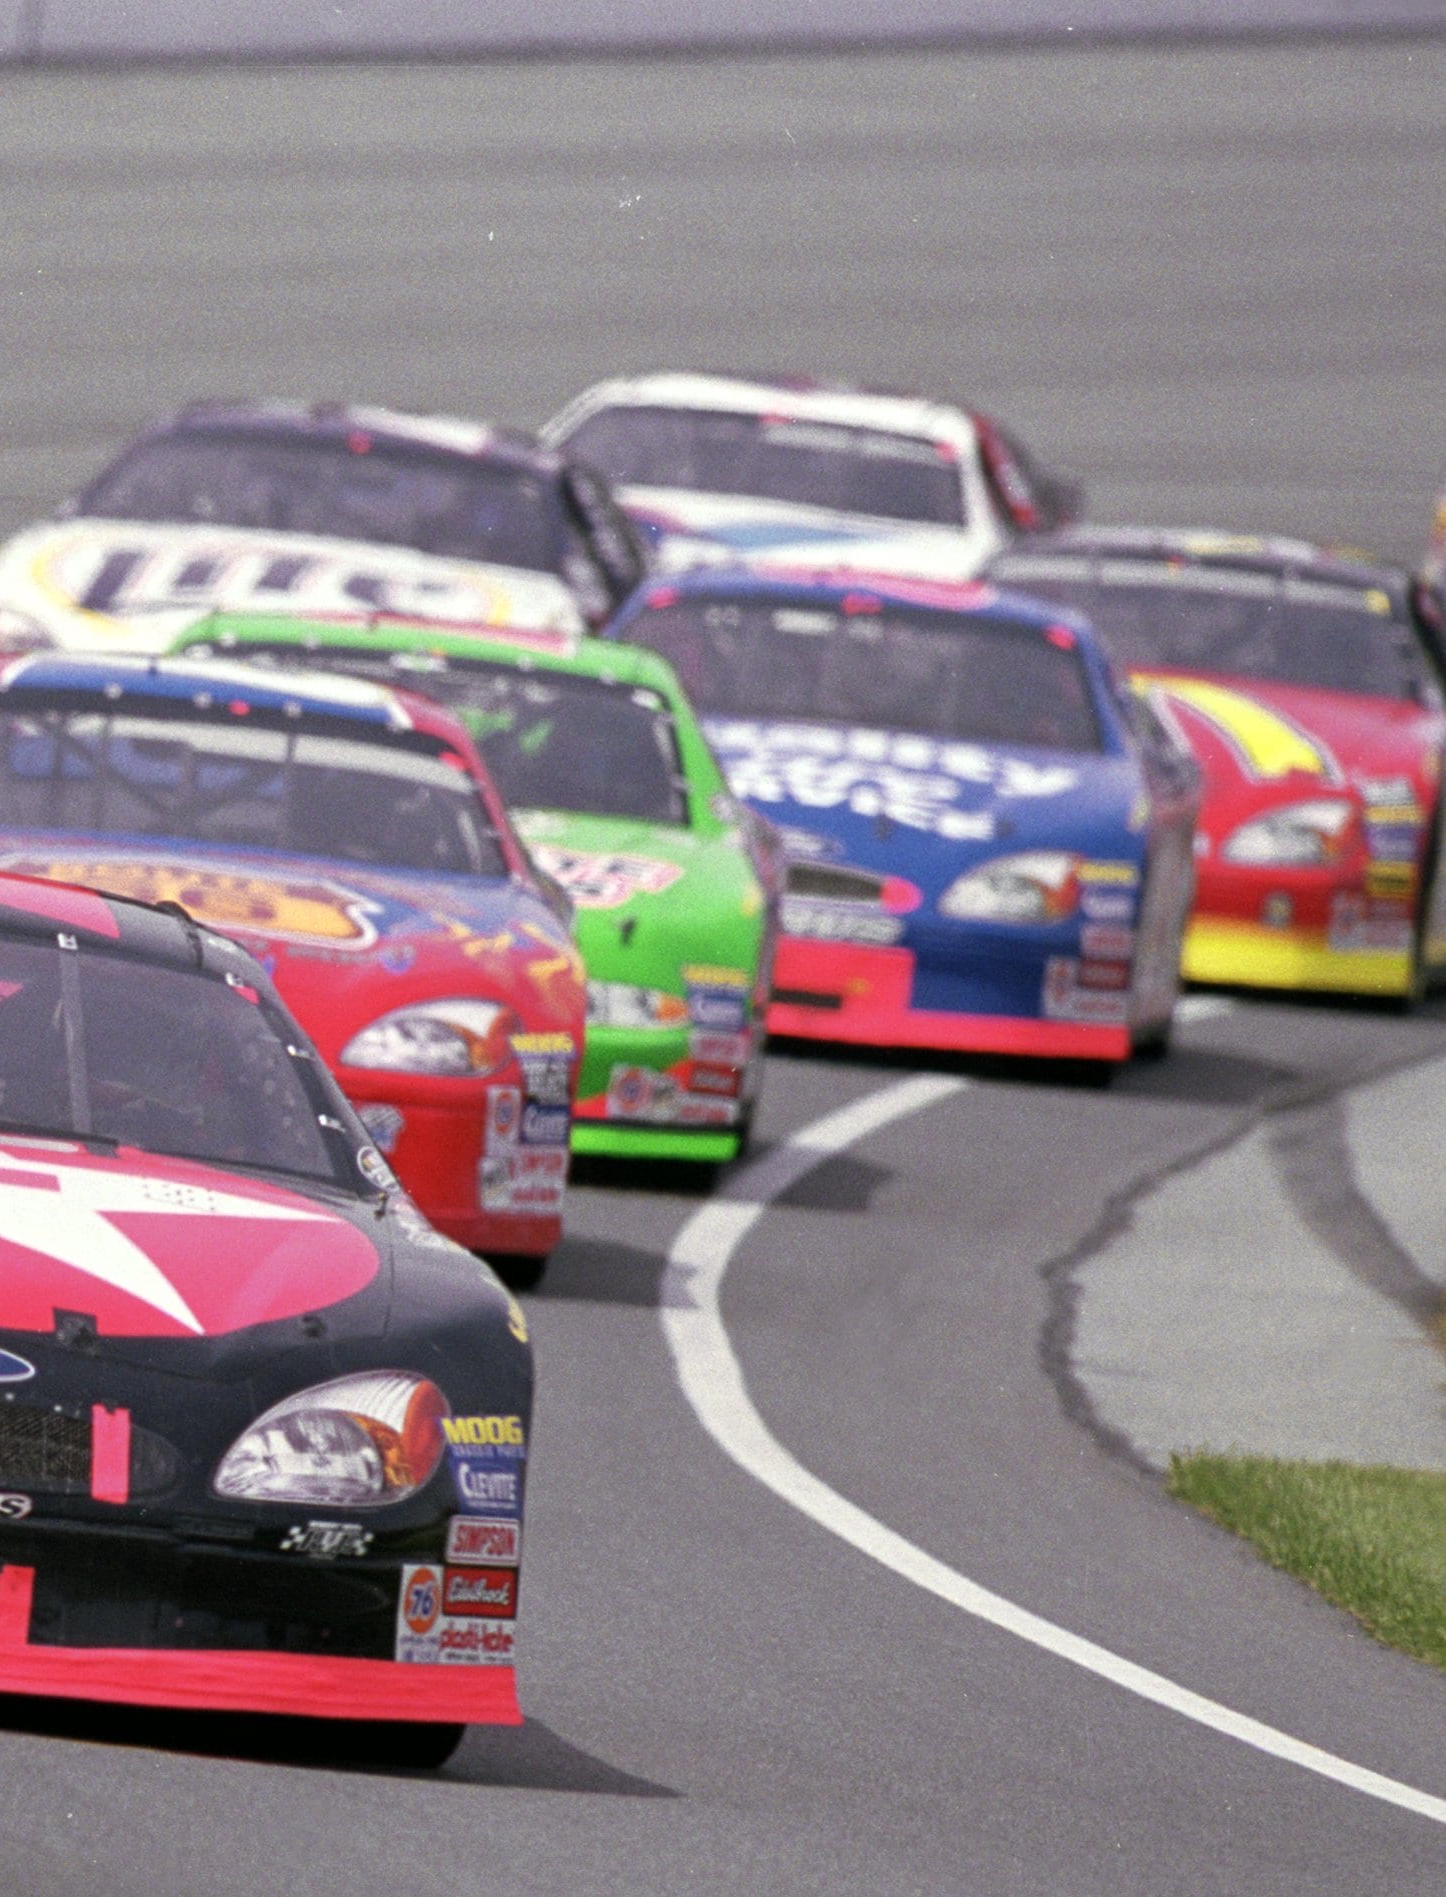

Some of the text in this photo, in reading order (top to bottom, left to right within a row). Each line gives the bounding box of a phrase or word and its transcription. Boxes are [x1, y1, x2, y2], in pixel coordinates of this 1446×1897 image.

[442, 1415, 524, 1445] MOOG
[454, 1523, 515, 1556] SIMPSON
[409, 1583, 435, 1617] 76
